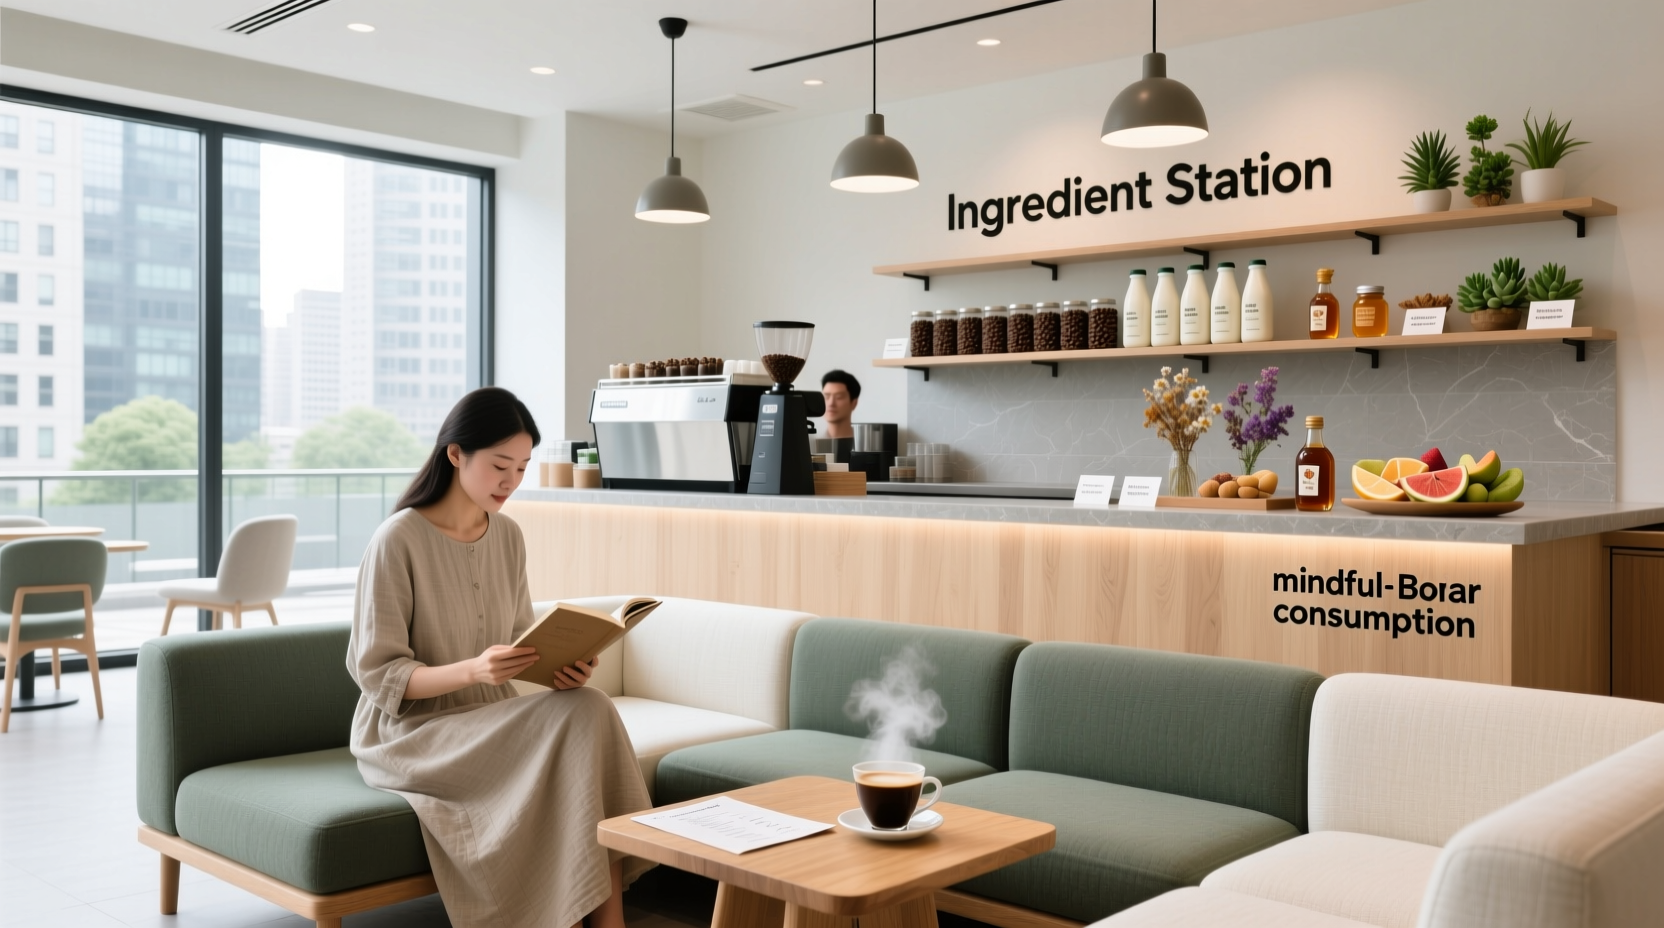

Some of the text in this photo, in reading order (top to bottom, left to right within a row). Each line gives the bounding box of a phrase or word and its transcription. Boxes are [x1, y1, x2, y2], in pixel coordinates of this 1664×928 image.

[948, 151, 1332, 238] Ingredient Station
[1272, 602, 1476, 639] consumption
